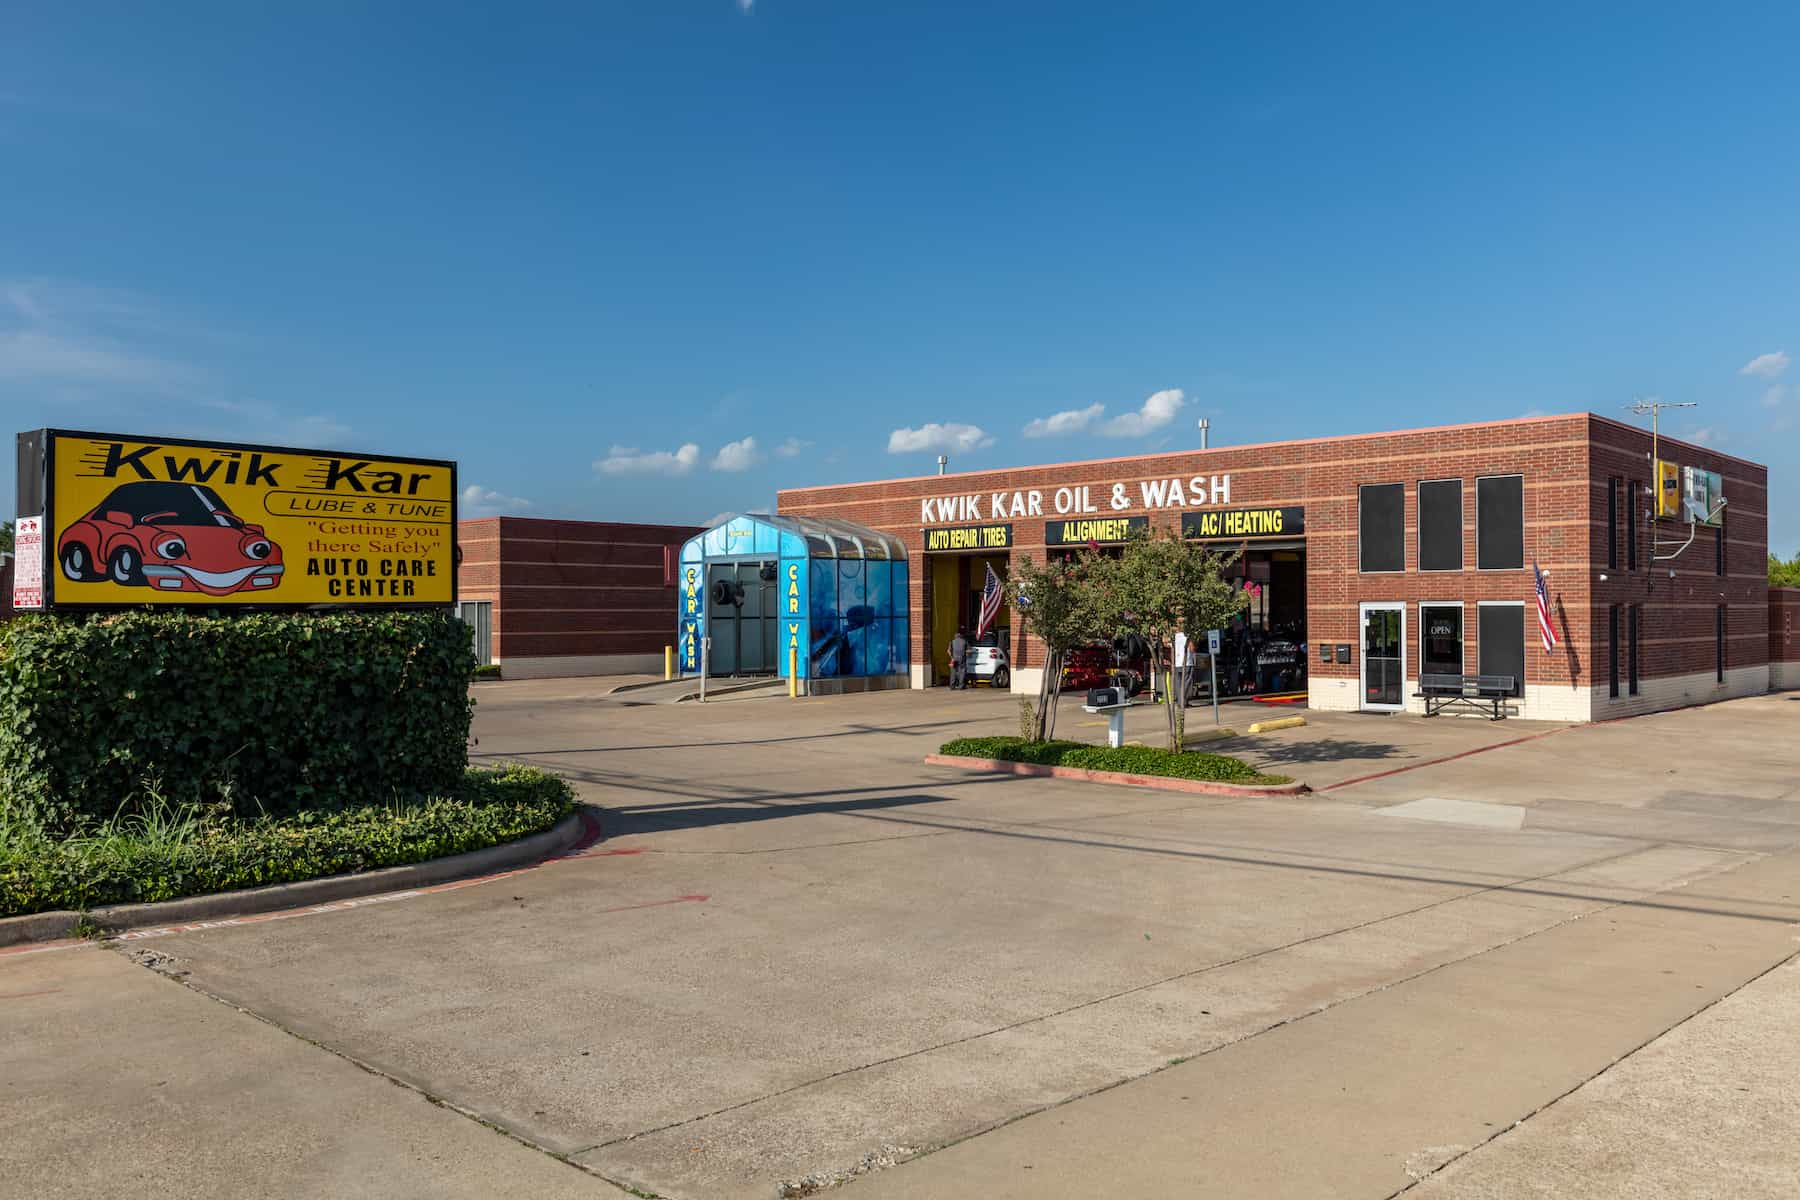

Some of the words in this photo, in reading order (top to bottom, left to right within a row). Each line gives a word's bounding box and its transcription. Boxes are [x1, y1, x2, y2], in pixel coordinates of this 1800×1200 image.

[103, 443, 283, 487] Kwik
[325, 459, 432, 495] Kar
[289, 498, 356, 513] LUBE
[362, 502, 377, 514] &
[387, 503, 447, 518] TUNE
[921, 495, 982, 523] KWIK
[991, 490, 1043, 519] KAR
[1055, 486, 1097, 514] OIL
[1110, 482, 1131, 511] &
[1141, 474, 1231, 509] WASH
[307, 521, 397, 539] "Getting
[404, 527, 440, 539] you
[1062, 519, 1129, 542] ALIGNMENT
[1225, 510, 1283, 534] HEATING
[307, 539, 361, 553] there
[368, 540, 441, 558] Safely"
[928, 530, 949, 550] AUTO
[950, 528, 977, 549] REPAIR
[982, 526, 1007, 547] TIRES
[307, 558, 368, 576] AUTO
[380, 559, 436, 577] CARE
[328, 579, 415, 597] CENTER
[687, 568, 696, 614] CAR
[788, 564, 800, 613] CAR
[1431, 626, 1450, 634] OPEN
[686, 623, 696, 668] WASH
